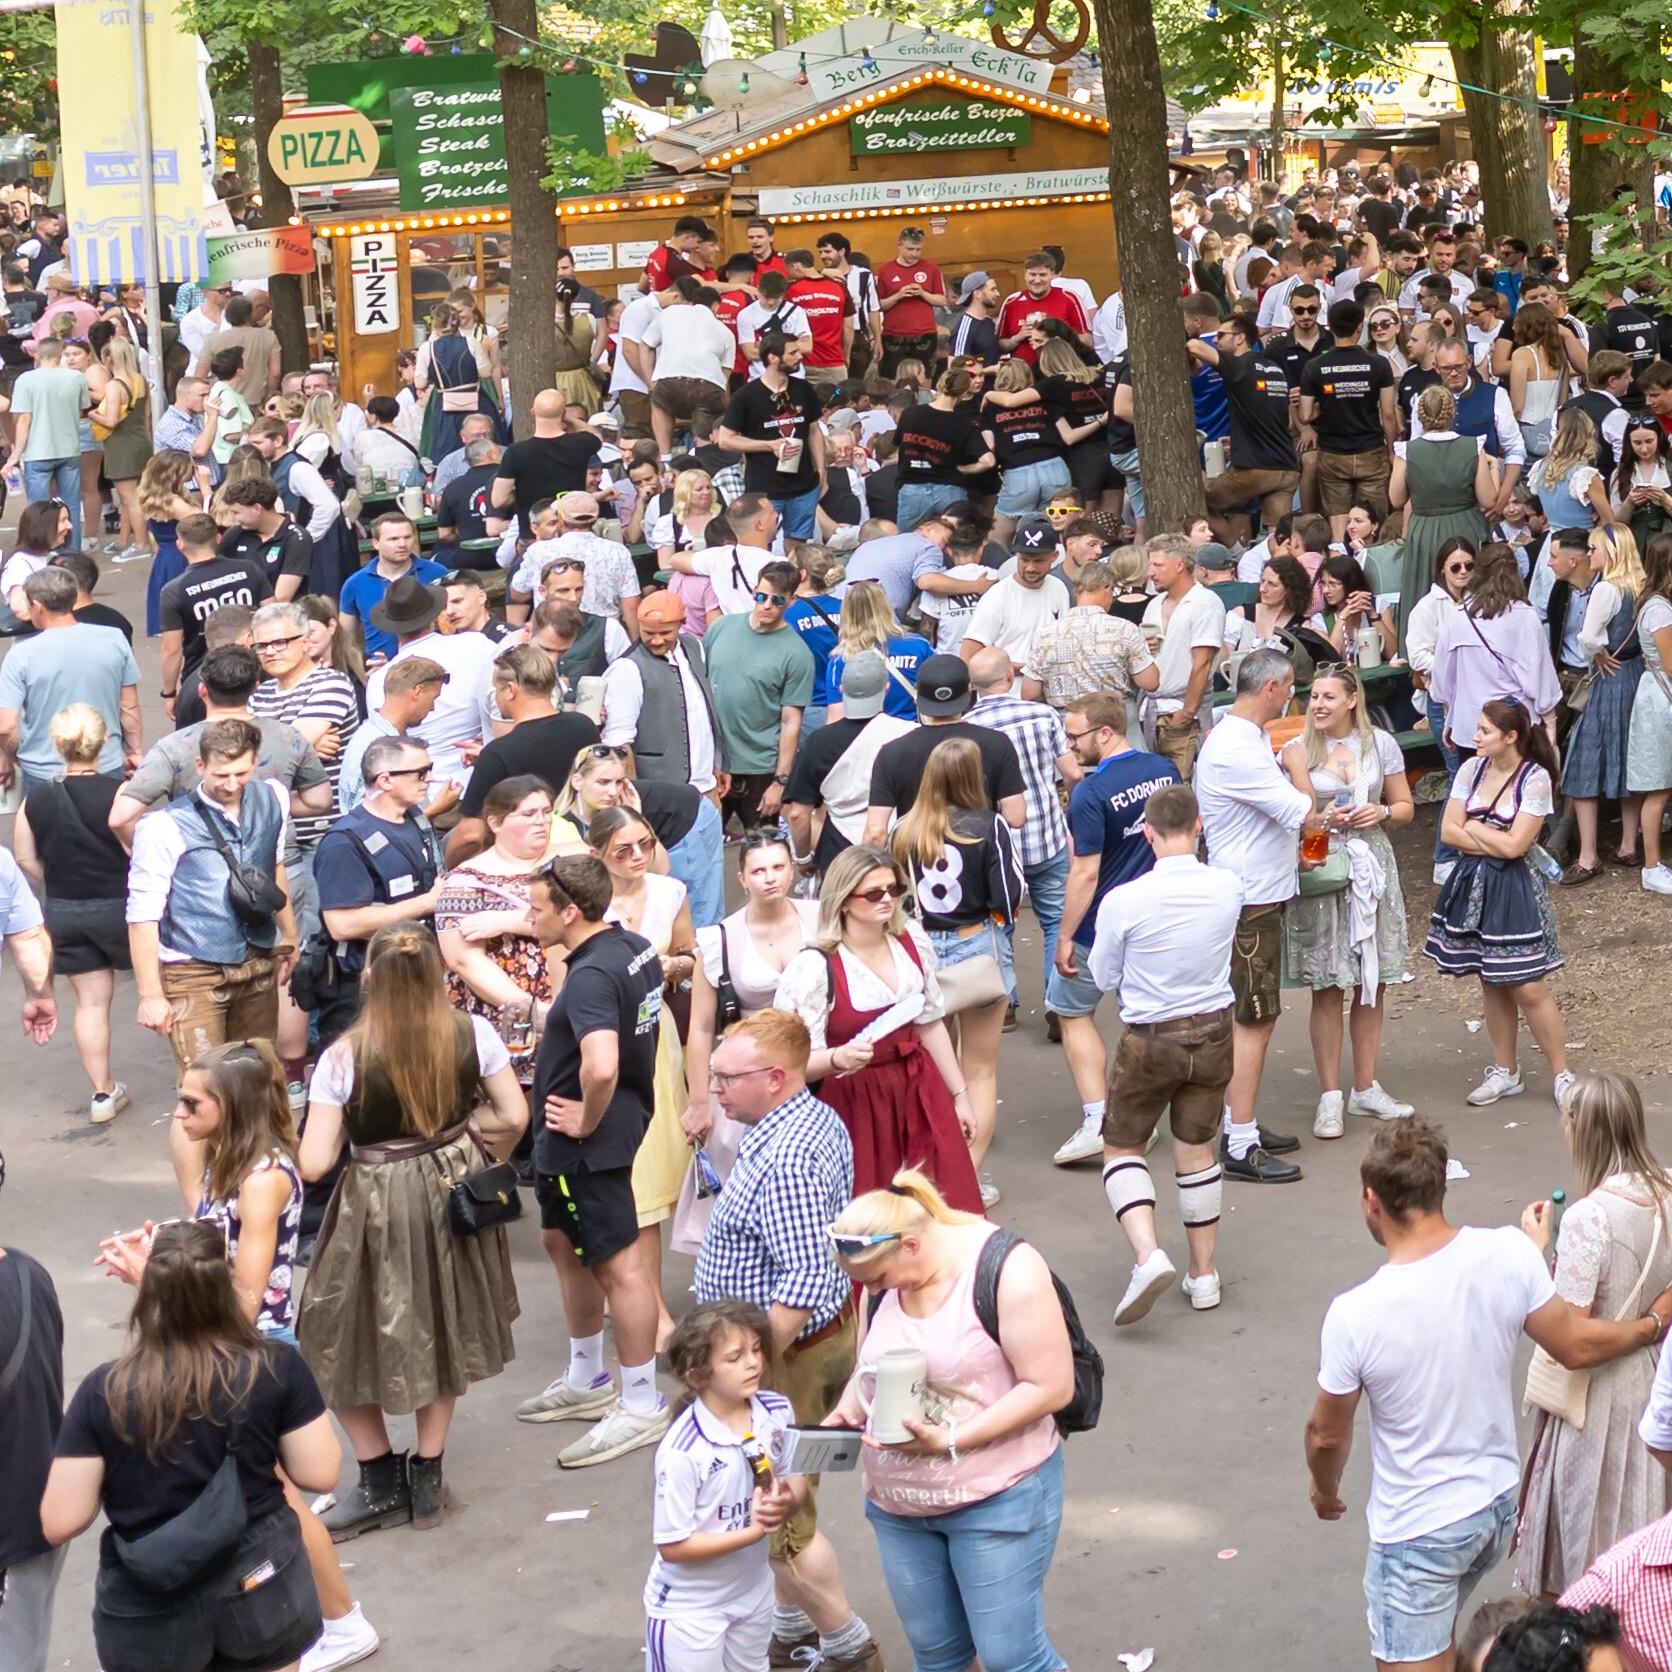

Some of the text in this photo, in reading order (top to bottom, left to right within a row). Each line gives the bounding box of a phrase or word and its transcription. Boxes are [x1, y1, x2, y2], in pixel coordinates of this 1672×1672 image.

[412, 88, 502, 108] Bratwü
[855, 102, 1026, 128] ofenfrische Brezen
[280, 128, 367, 171] PIZZA
[418, 133, 490, 155] Steak
[420, 179, 508, 203] Frische
[792, 186, 881, 207] Schaschlik
[905, 180, 1003, 199] Weißwürste
[275, 237, 309, 257] Pizza
[363, 239, 390, 327] PIZZA
[797, 617, 812, 631] FC
[1111, 791, 1129, 812] FC
[917, 844, 964, 914] 8
